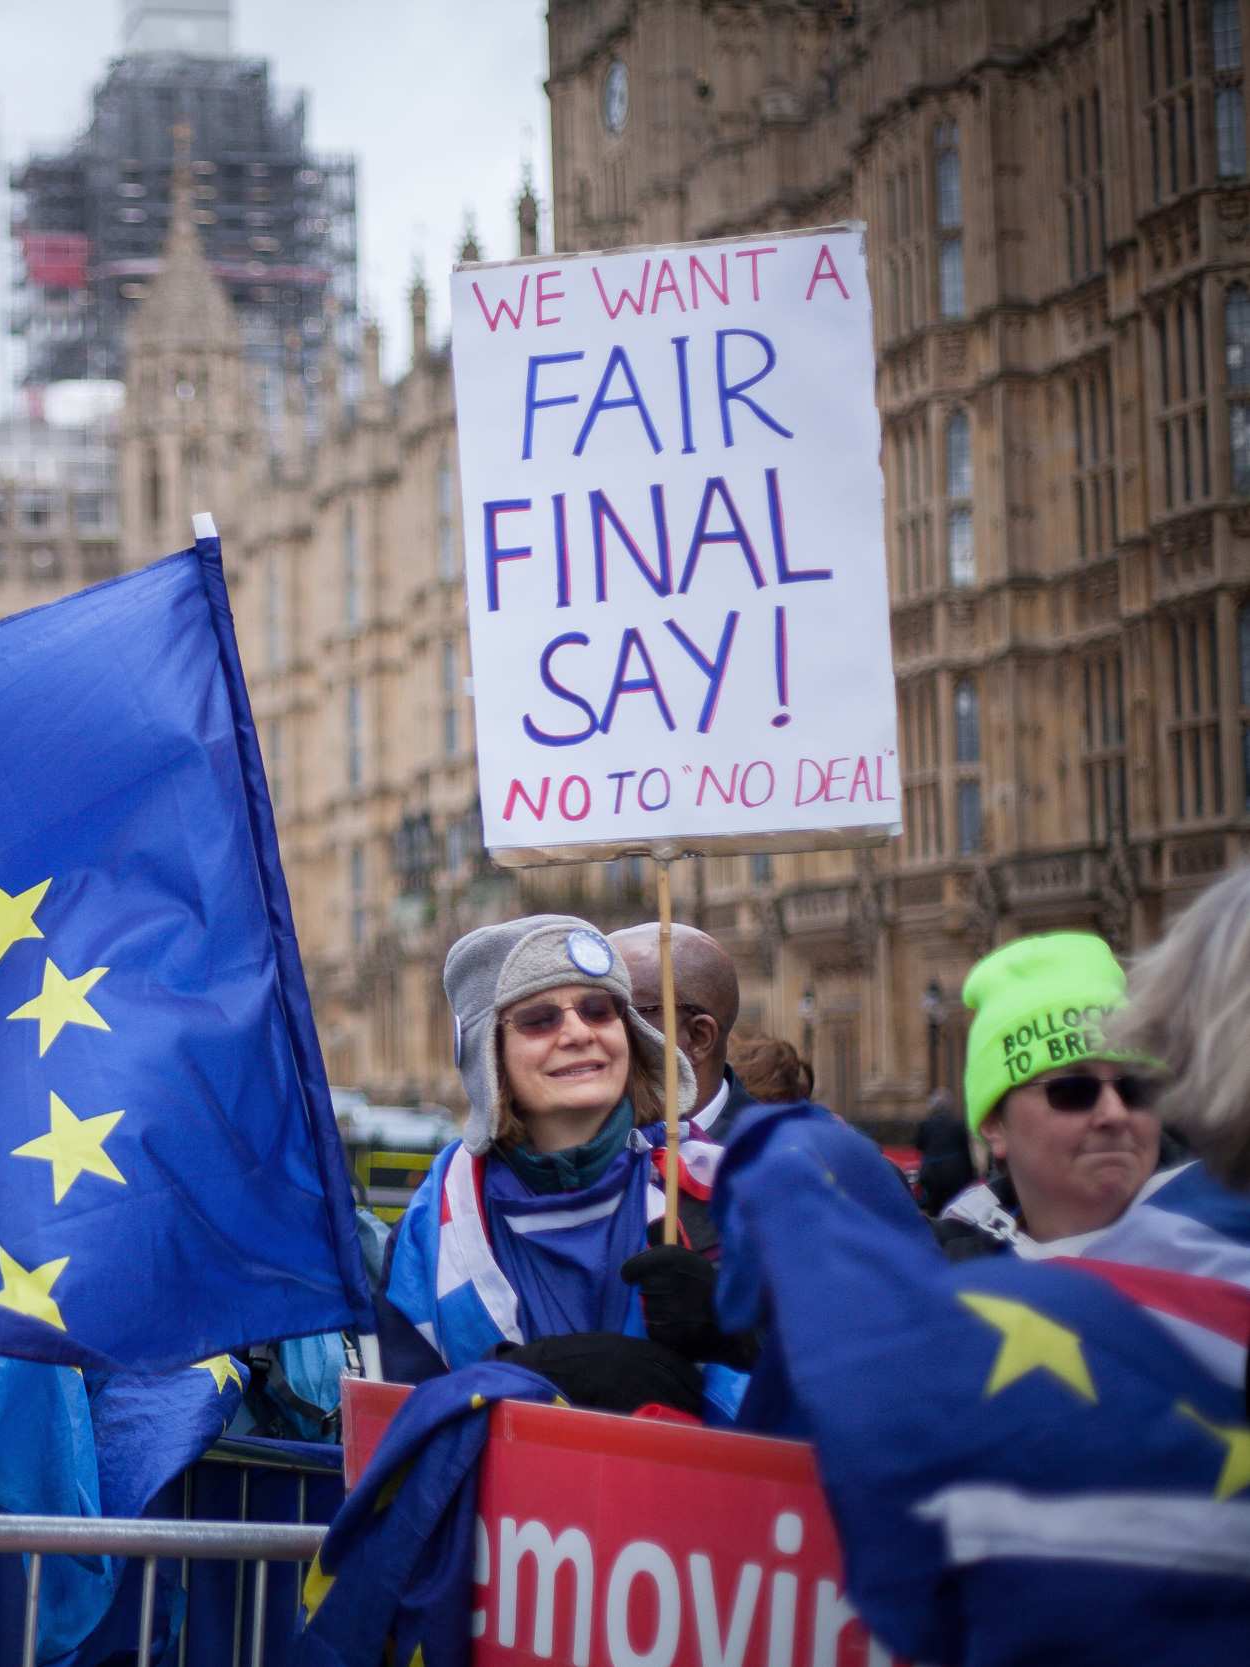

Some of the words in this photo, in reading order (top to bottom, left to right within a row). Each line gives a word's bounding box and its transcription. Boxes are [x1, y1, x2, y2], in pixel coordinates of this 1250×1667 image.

[472, 270, 565, 332] WE
[592, 247, 778, 320] WANT
[805, 244, 851, 301] A
[521, 328, 794, 461] FAIR
[483, 467, 833, 613] FINAL
[522, 605, 792, 747] SAY!
[502, 774, 592, 822] NO
[607, 767, 672, 815] TO
[681, 760, 776, 808] "NO
[1004, 1050, 1032, 1082] TO
